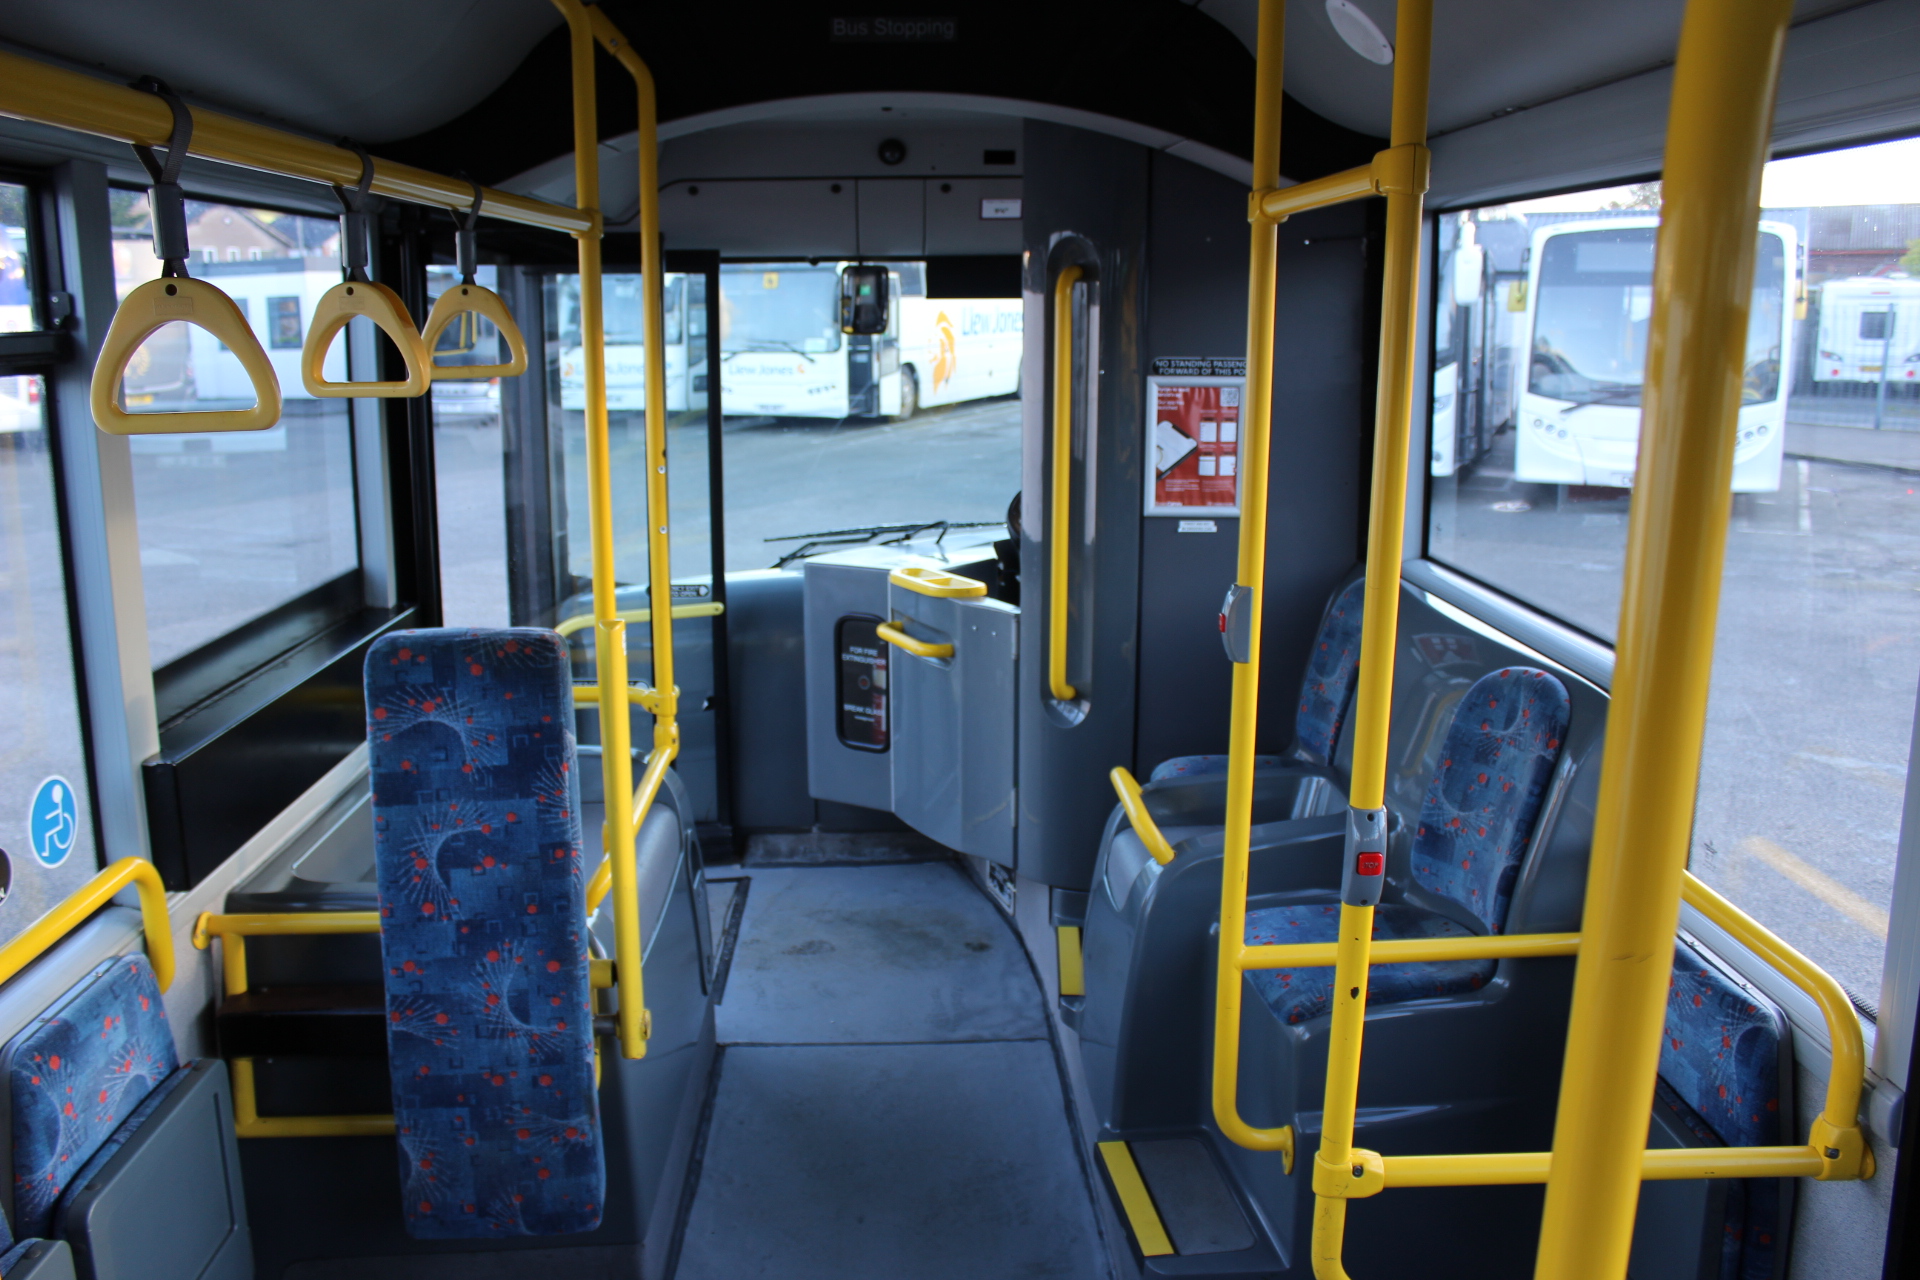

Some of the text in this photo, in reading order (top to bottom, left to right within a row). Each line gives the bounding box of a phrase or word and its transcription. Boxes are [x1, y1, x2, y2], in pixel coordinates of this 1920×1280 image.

[832, 17, 955, 39] Bus Stopping
[1156, 360, 1170, 368] NO
[1171, 360, 1212, 368] STANDING
[849, 646, 878, 657] FOR FIRE
[842, 653, 887, 666] EXTINGUISHER
[843, 703, 864, 713] BREAK
